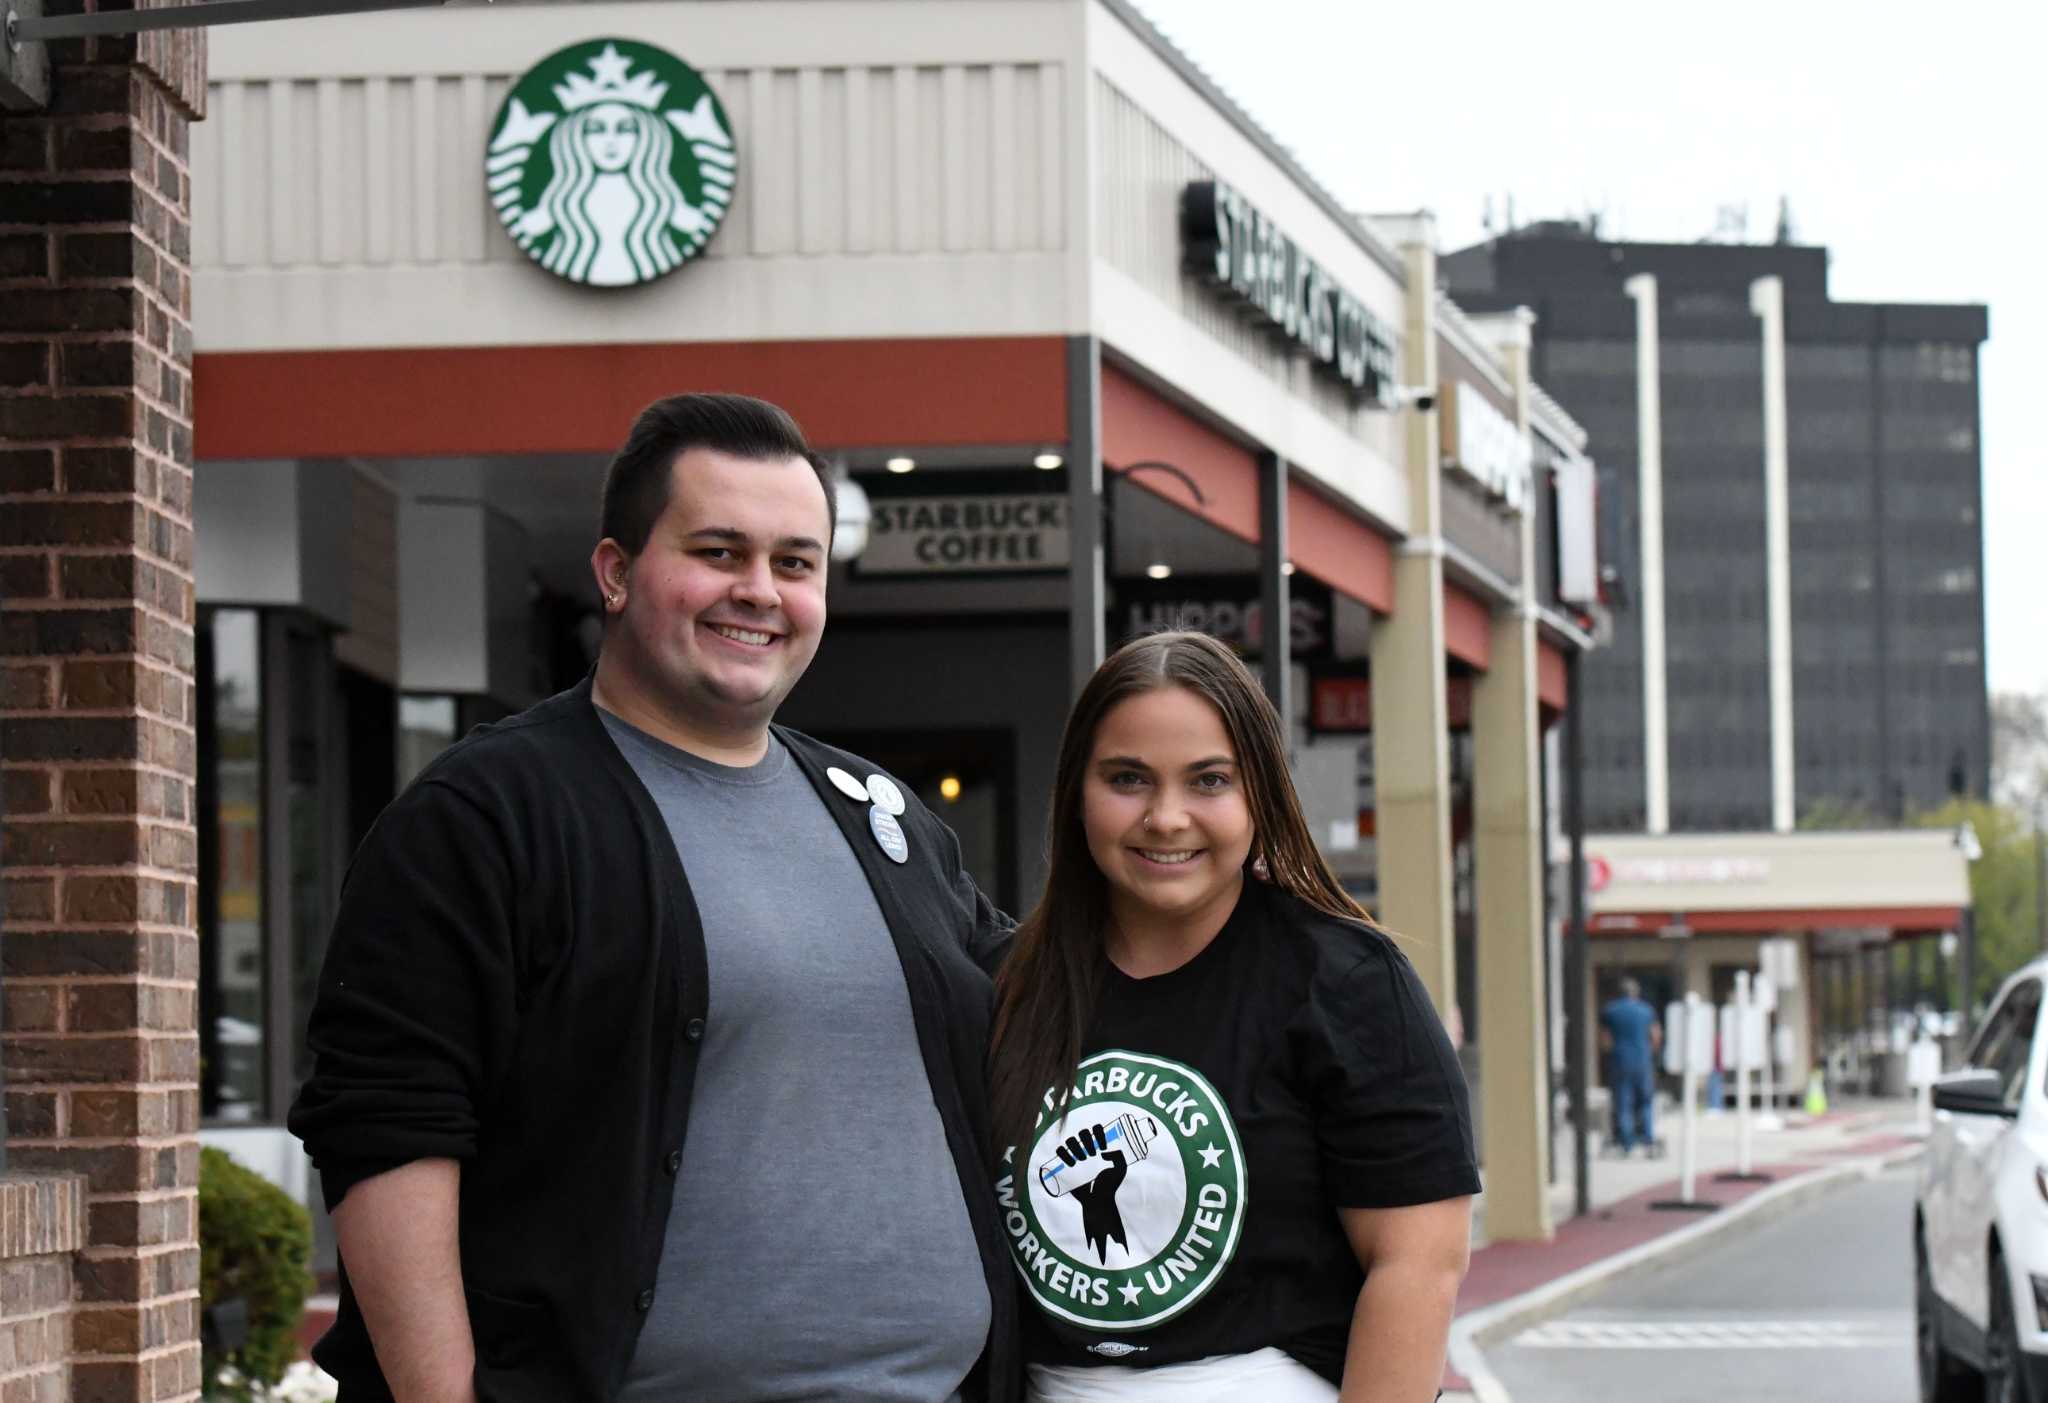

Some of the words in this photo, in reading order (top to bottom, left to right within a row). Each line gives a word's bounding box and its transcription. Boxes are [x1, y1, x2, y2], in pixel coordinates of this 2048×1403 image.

[873, 502, 1065, 533] STARBUCK
[915, 534, 1042, 563] COFFEE
[1033, 1066, 1209, 1138] TARBUCKS
[995, 1174, 1110, 1306] WORKERS
[1145, 1183, 1227, 1296] UNITED
